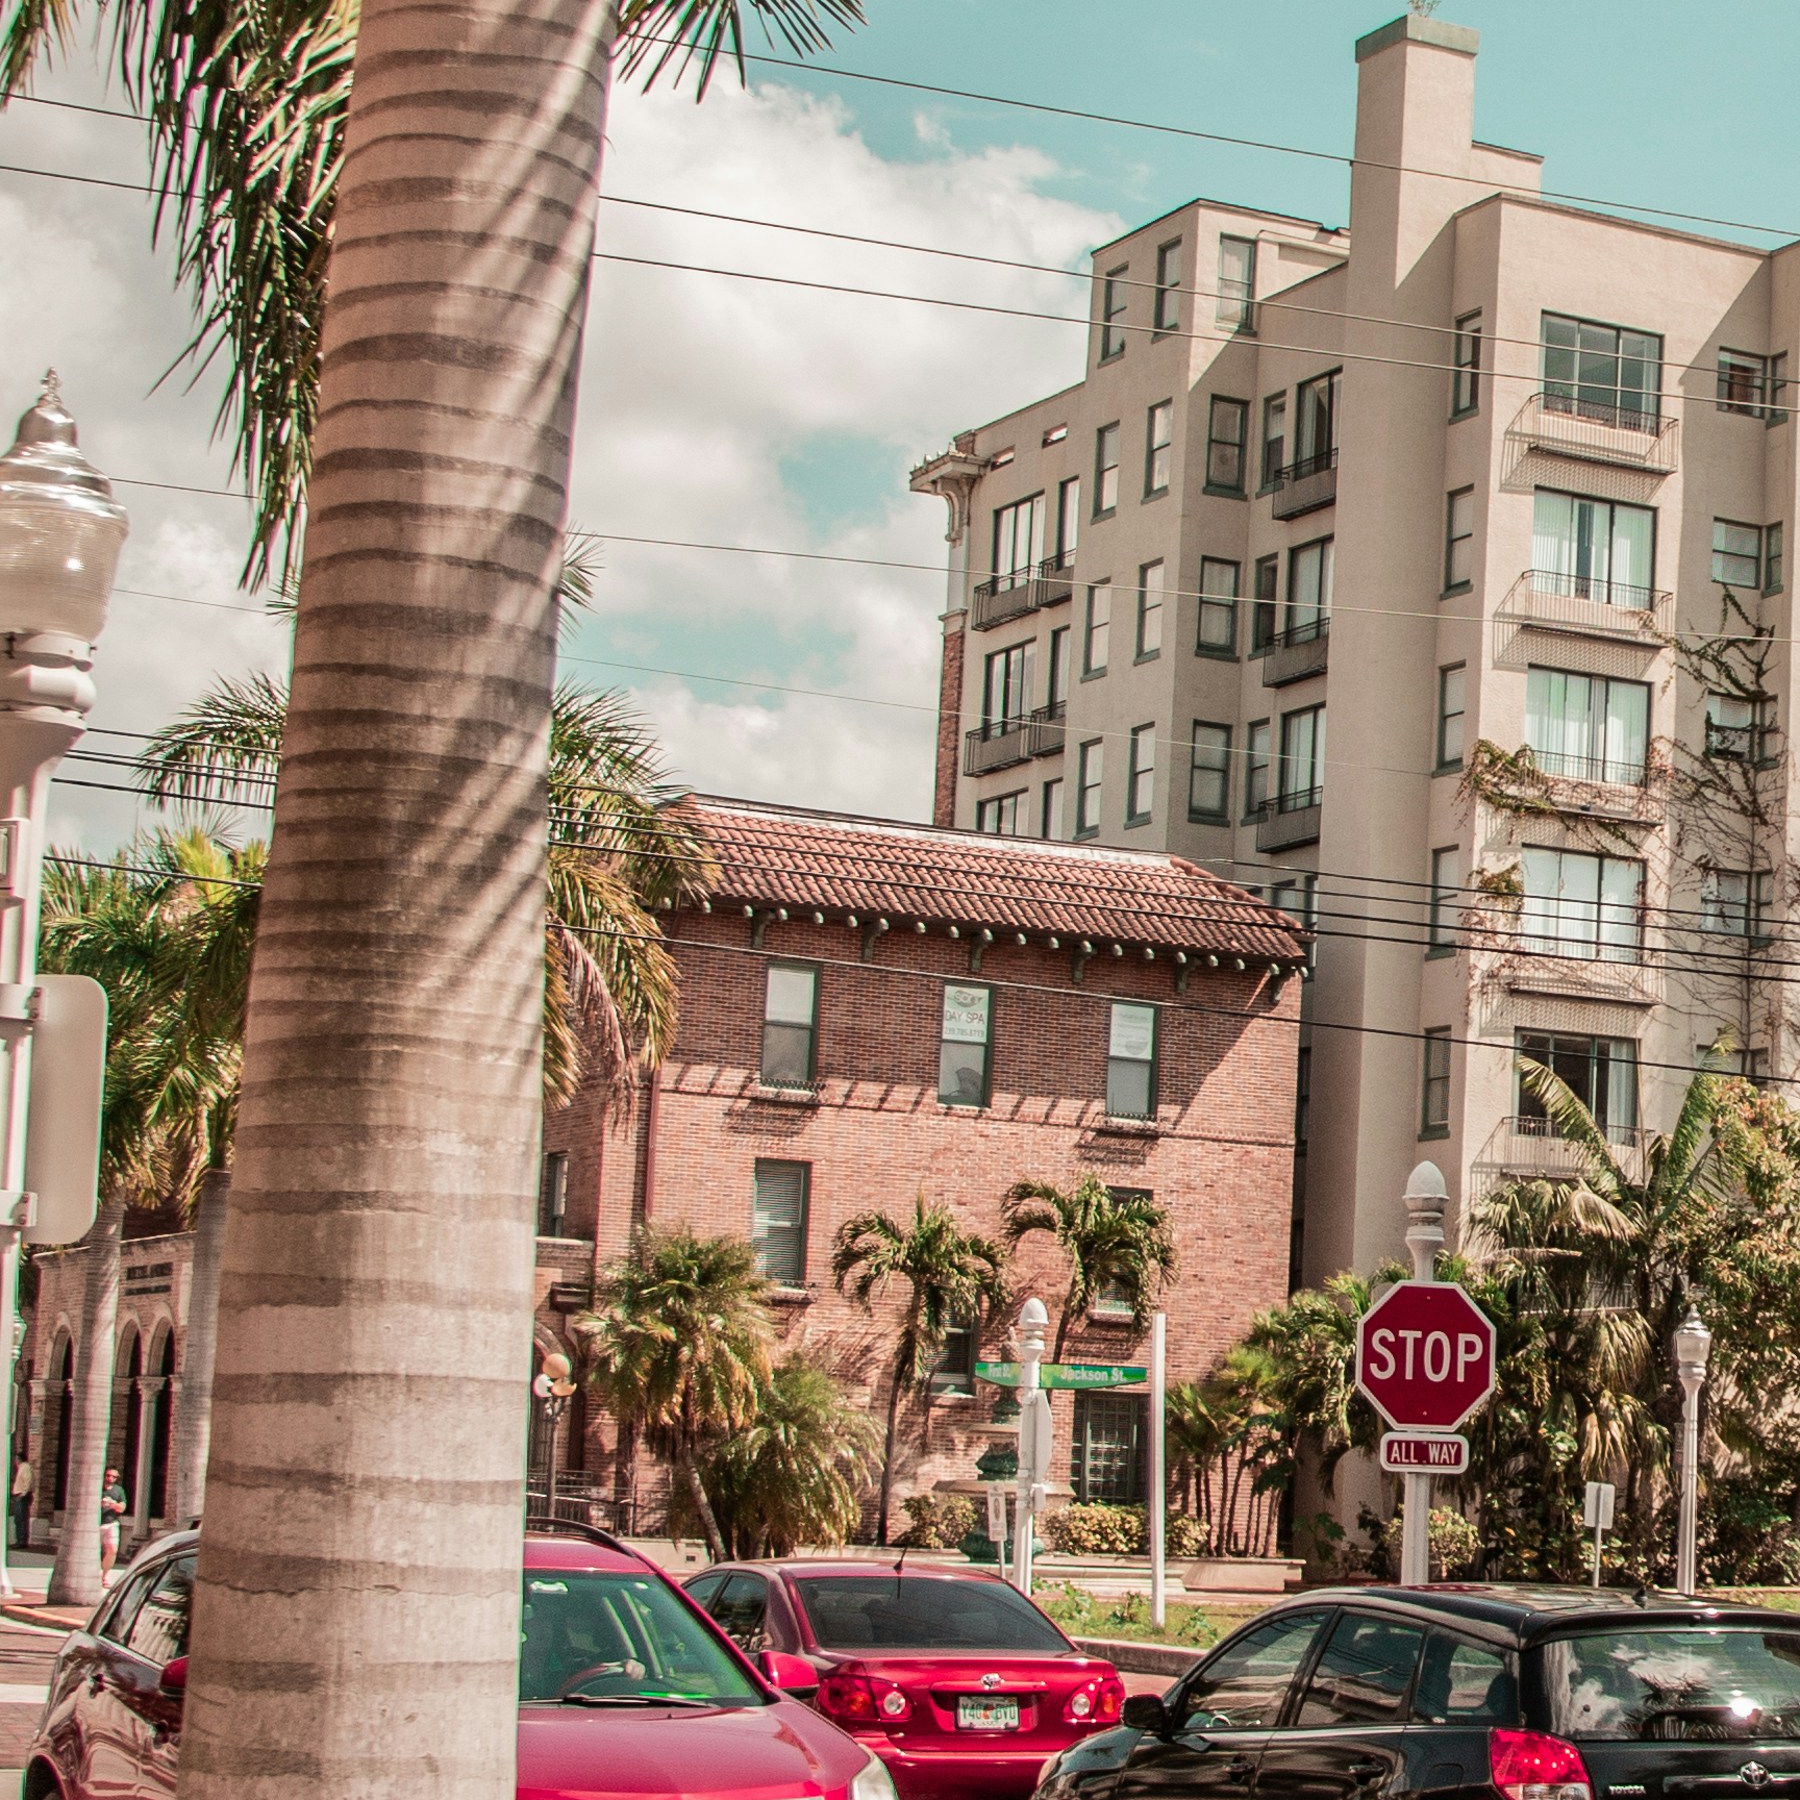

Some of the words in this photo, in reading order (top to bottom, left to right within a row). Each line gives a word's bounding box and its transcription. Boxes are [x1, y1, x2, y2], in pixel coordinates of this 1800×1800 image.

[945, 1010, 963, 1022] DAY
[966, 1012, 985, 1025] SPA
[1369, 1328, 1483, 1382] STOP
[1061, 1366, 1108, 1382] Jackson
[1111, 1367, 1127, 1382] St.
[1390, 1442, 1418, 1463] ALL
[1428, 1443, 1458, 1465] WAY
[1608, 1785, 1647, 1795] TOYOTA
